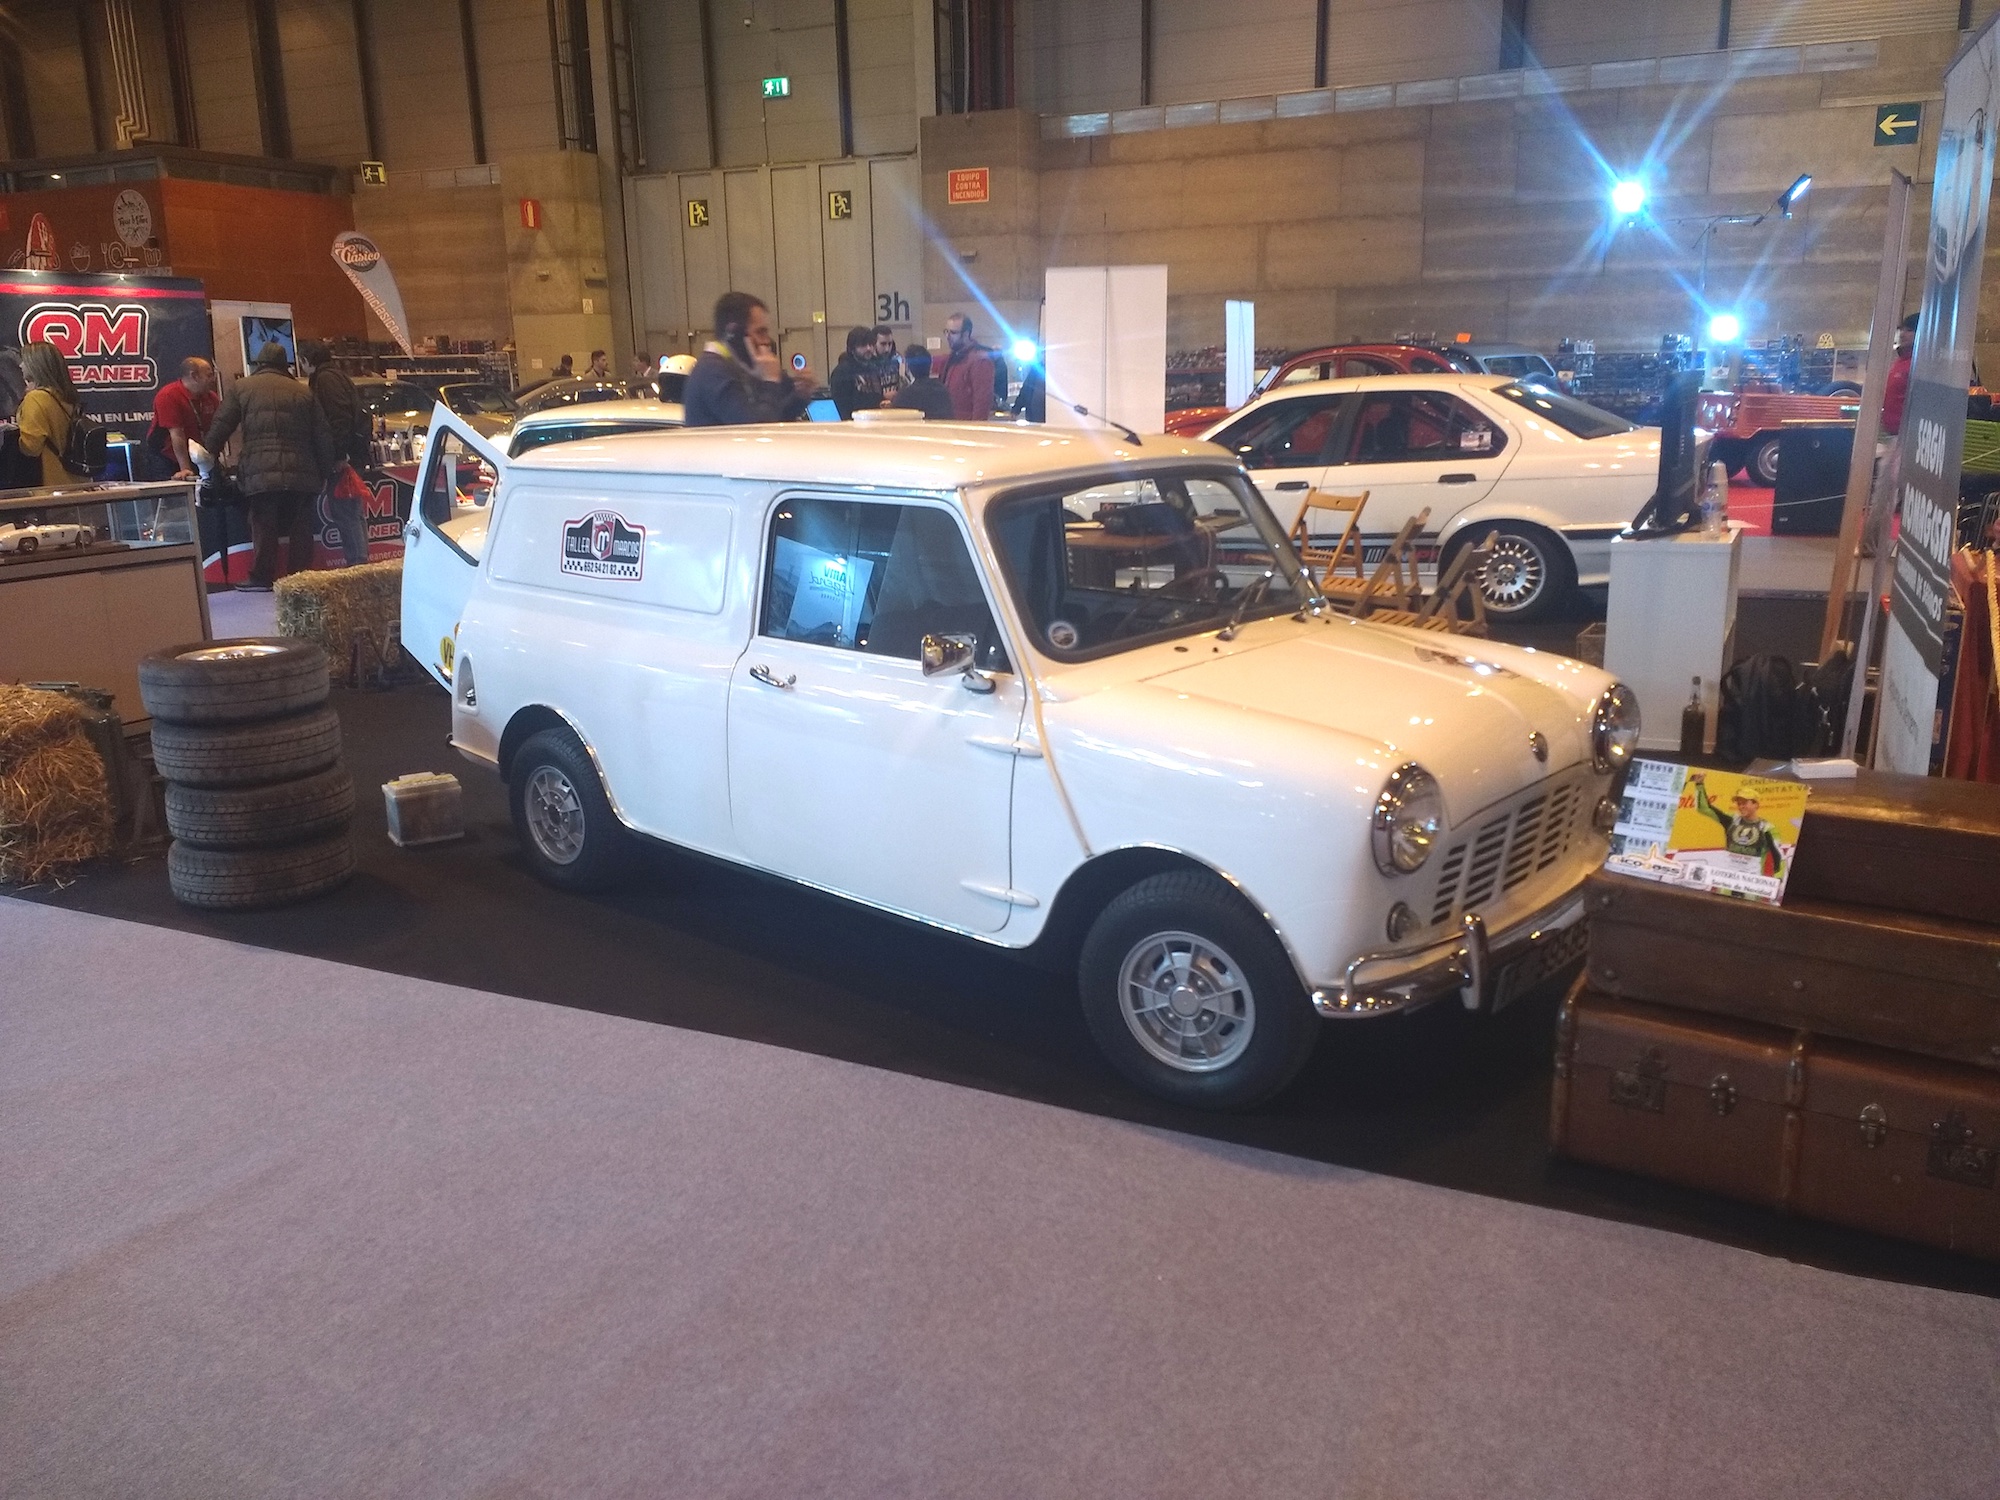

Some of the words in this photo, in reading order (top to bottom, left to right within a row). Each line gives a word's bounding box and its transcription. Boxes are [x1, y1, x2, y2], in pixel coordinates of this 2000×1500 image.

[957, 172, 980, 181] EQUIPO
[955, 181, 981, 191] CONTRA
[952, 189, 985, 200] INCENDIOS
[877, 291, 910, 321] 3h
[26, 311, 142, 357] QM
[68, 365, 150, 383] EANER
[105, 413, 122, 423] EN
[567, 535, 591, 554] TALLER
[613, 539, 640, 558] MARCOS
